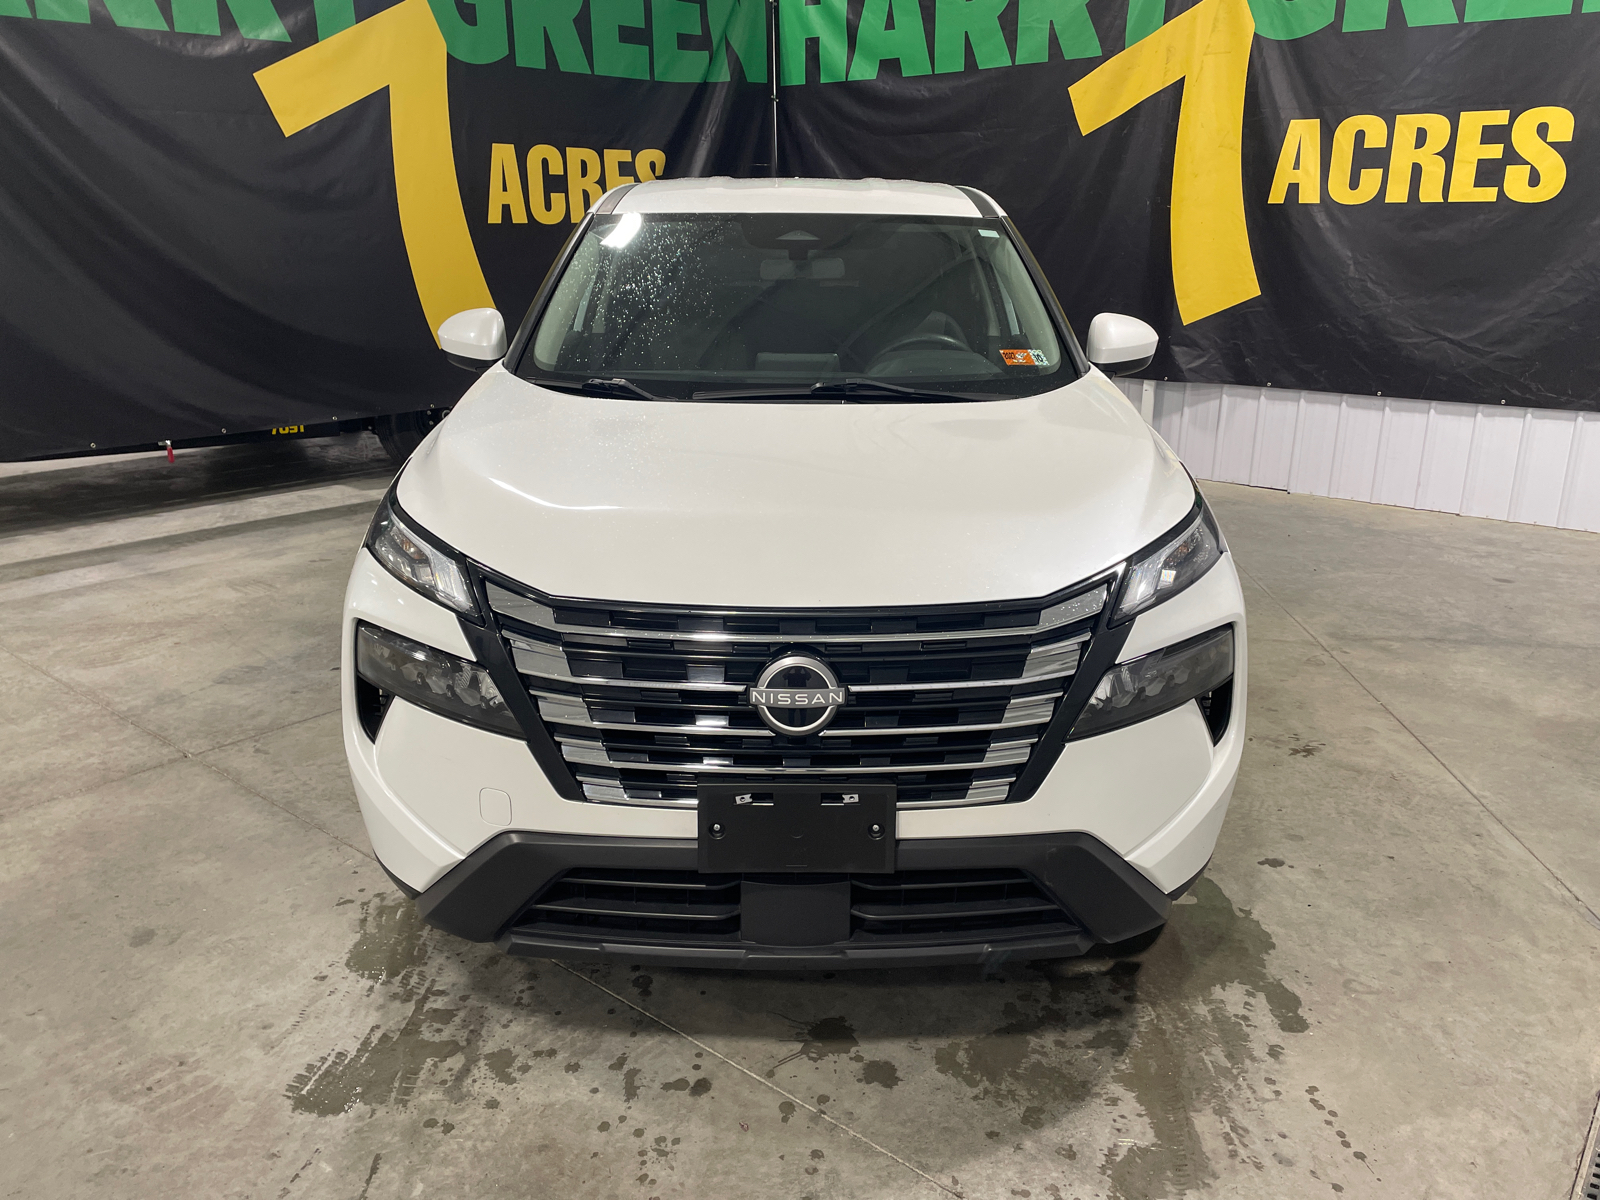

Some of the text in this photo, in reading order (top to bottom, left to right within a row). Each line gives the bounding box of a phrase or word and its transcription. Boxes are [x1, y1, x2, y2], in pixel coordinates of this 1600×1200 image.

[779, 0, 1166, 87] HARR
[253, 0, 498, 350] 7
[1067, 0, 1576, 326] 7 ACRES
[752, 691, 843, 705] NISSAN
